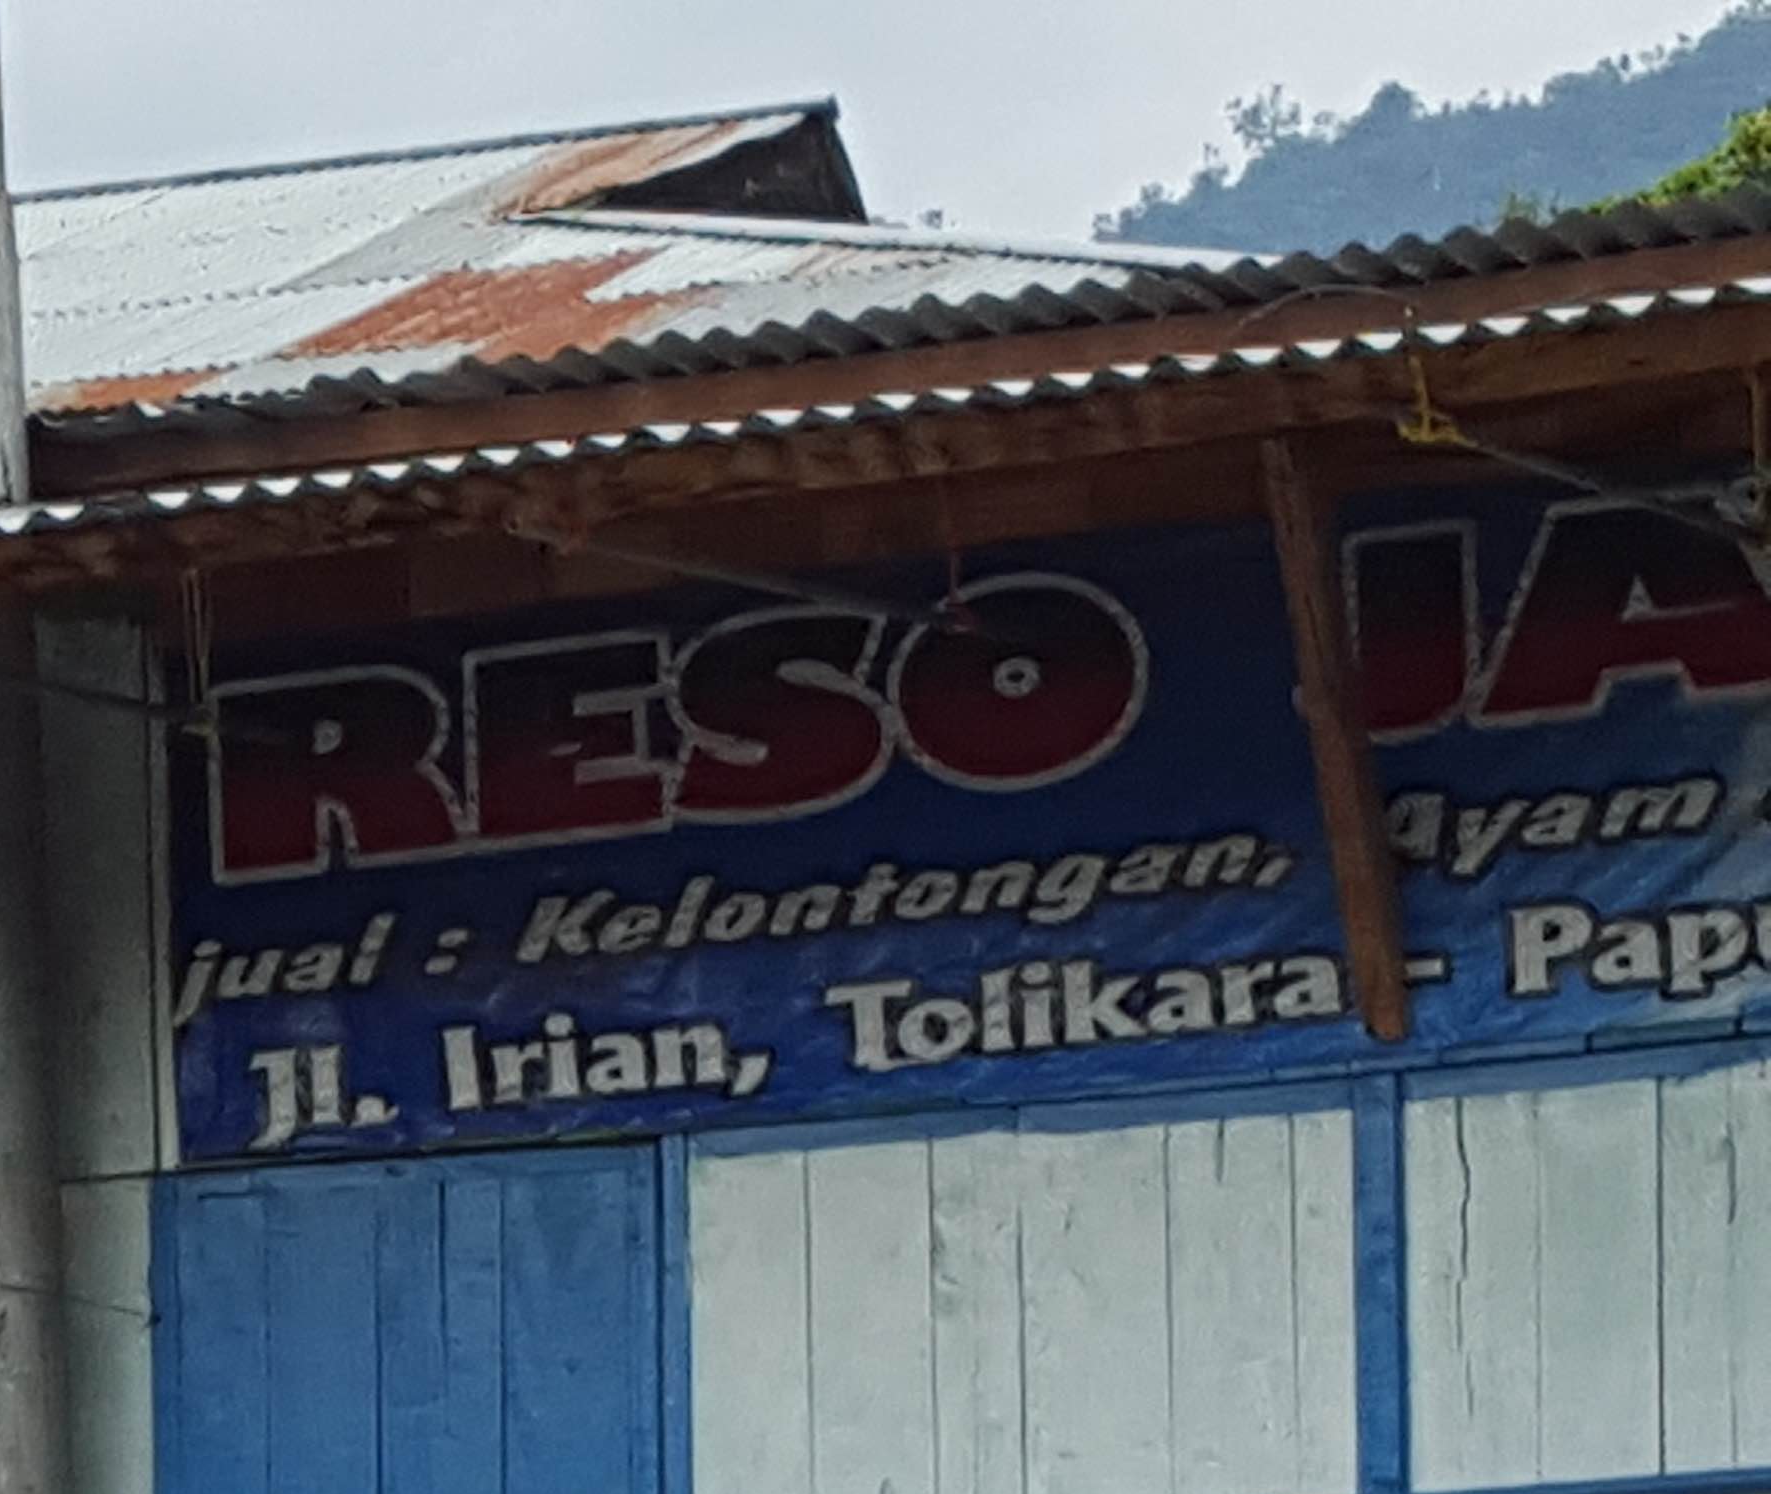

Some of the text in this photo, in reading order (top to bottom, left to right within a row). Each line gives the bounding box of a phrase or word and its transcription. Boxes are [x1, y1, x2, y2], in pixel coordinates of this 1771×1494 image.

[207, 570, 1151, 887] RESO
[515, 831, 1294, 964] Kelontongan,
[439, 1012, 772, 1112] Irian,
[825, 952, 1344, 1072] Tolikara
[1509, 902, 1771, 999] Pap
